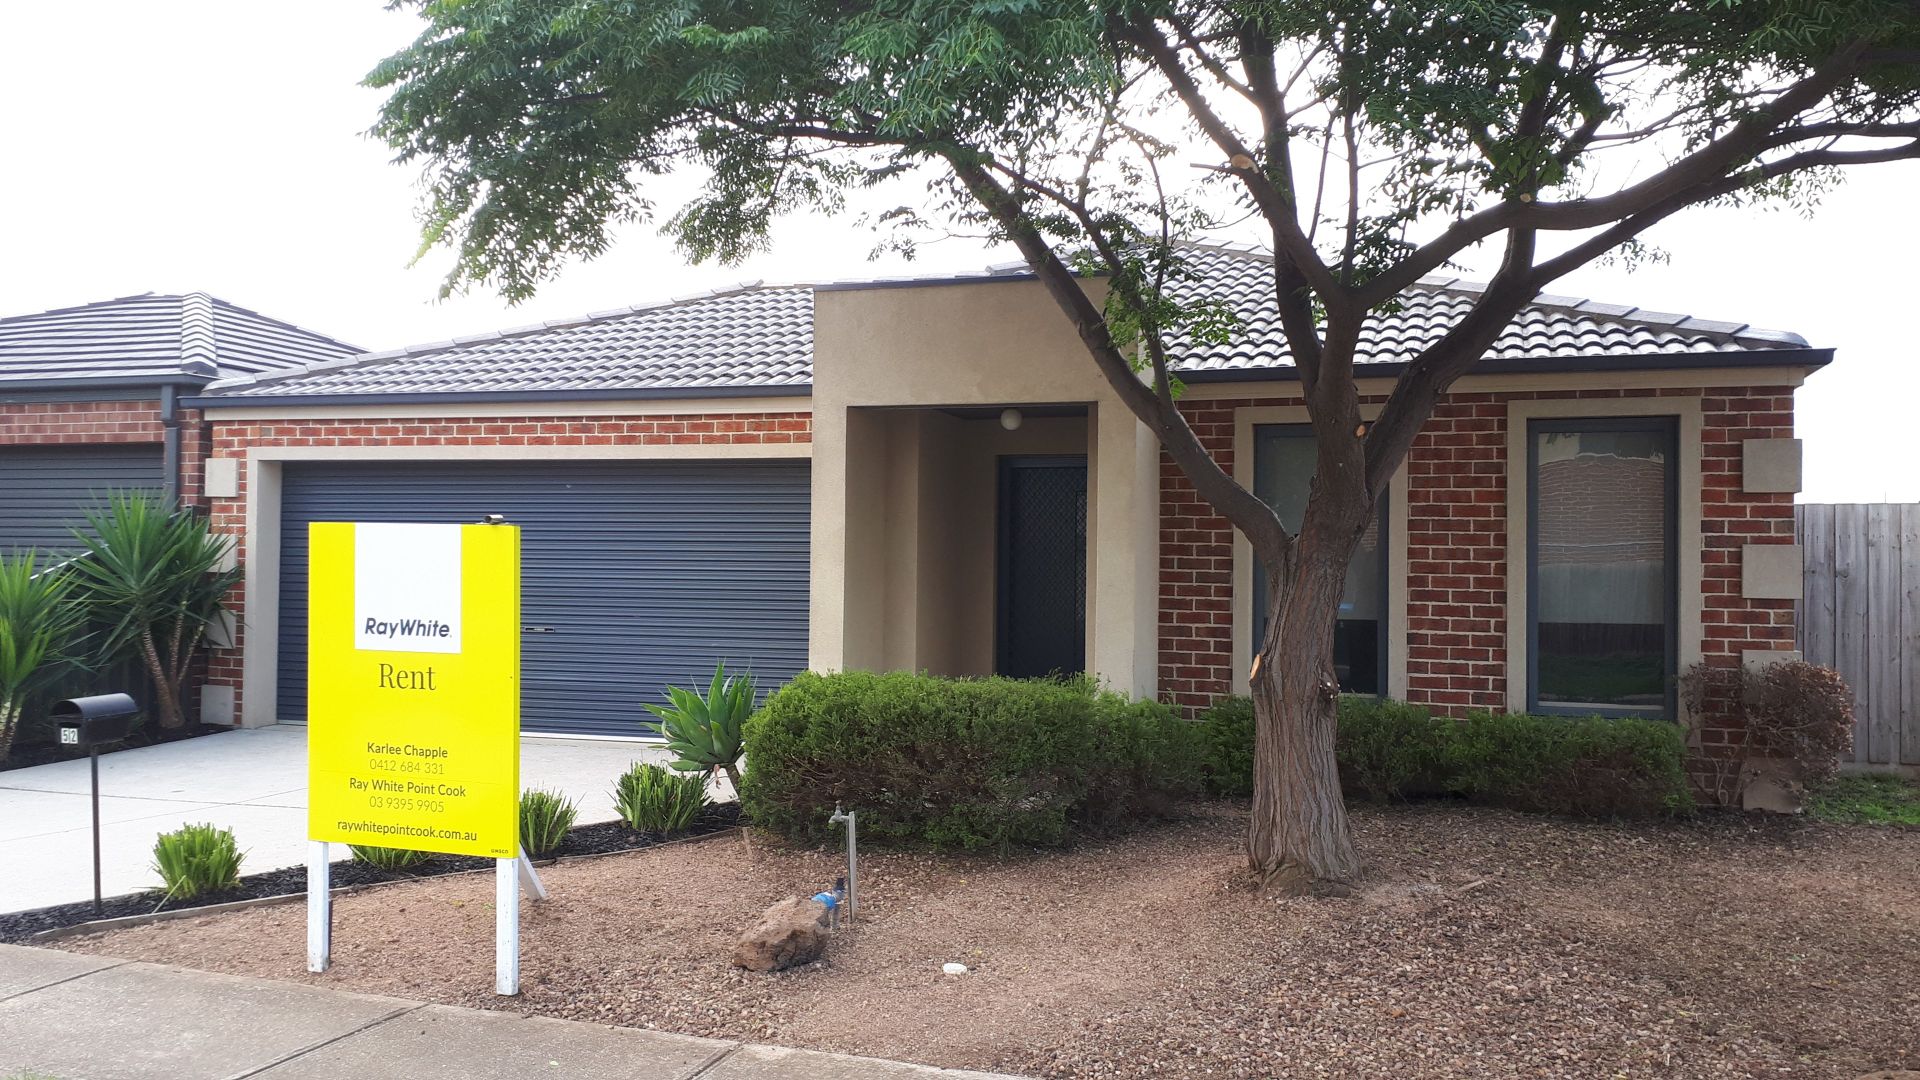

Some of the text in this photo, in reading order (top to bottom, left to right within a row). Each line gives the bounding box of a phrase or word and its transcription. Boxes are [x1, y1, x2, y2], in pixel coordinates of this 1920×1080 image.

[379, 663, 436, 691] Rent
[63, 729, 77, 742] 52
[367, 742, 448, 759] Karlee Chapple
[369, 758, 445, 775] 0412 684 331
[349, 777, 466, 797] Ray White Point Cook
[369, 796, 445, 813] 03 9395 9905
[337, 820, 477, 841] raywhitepointcook.com.au
